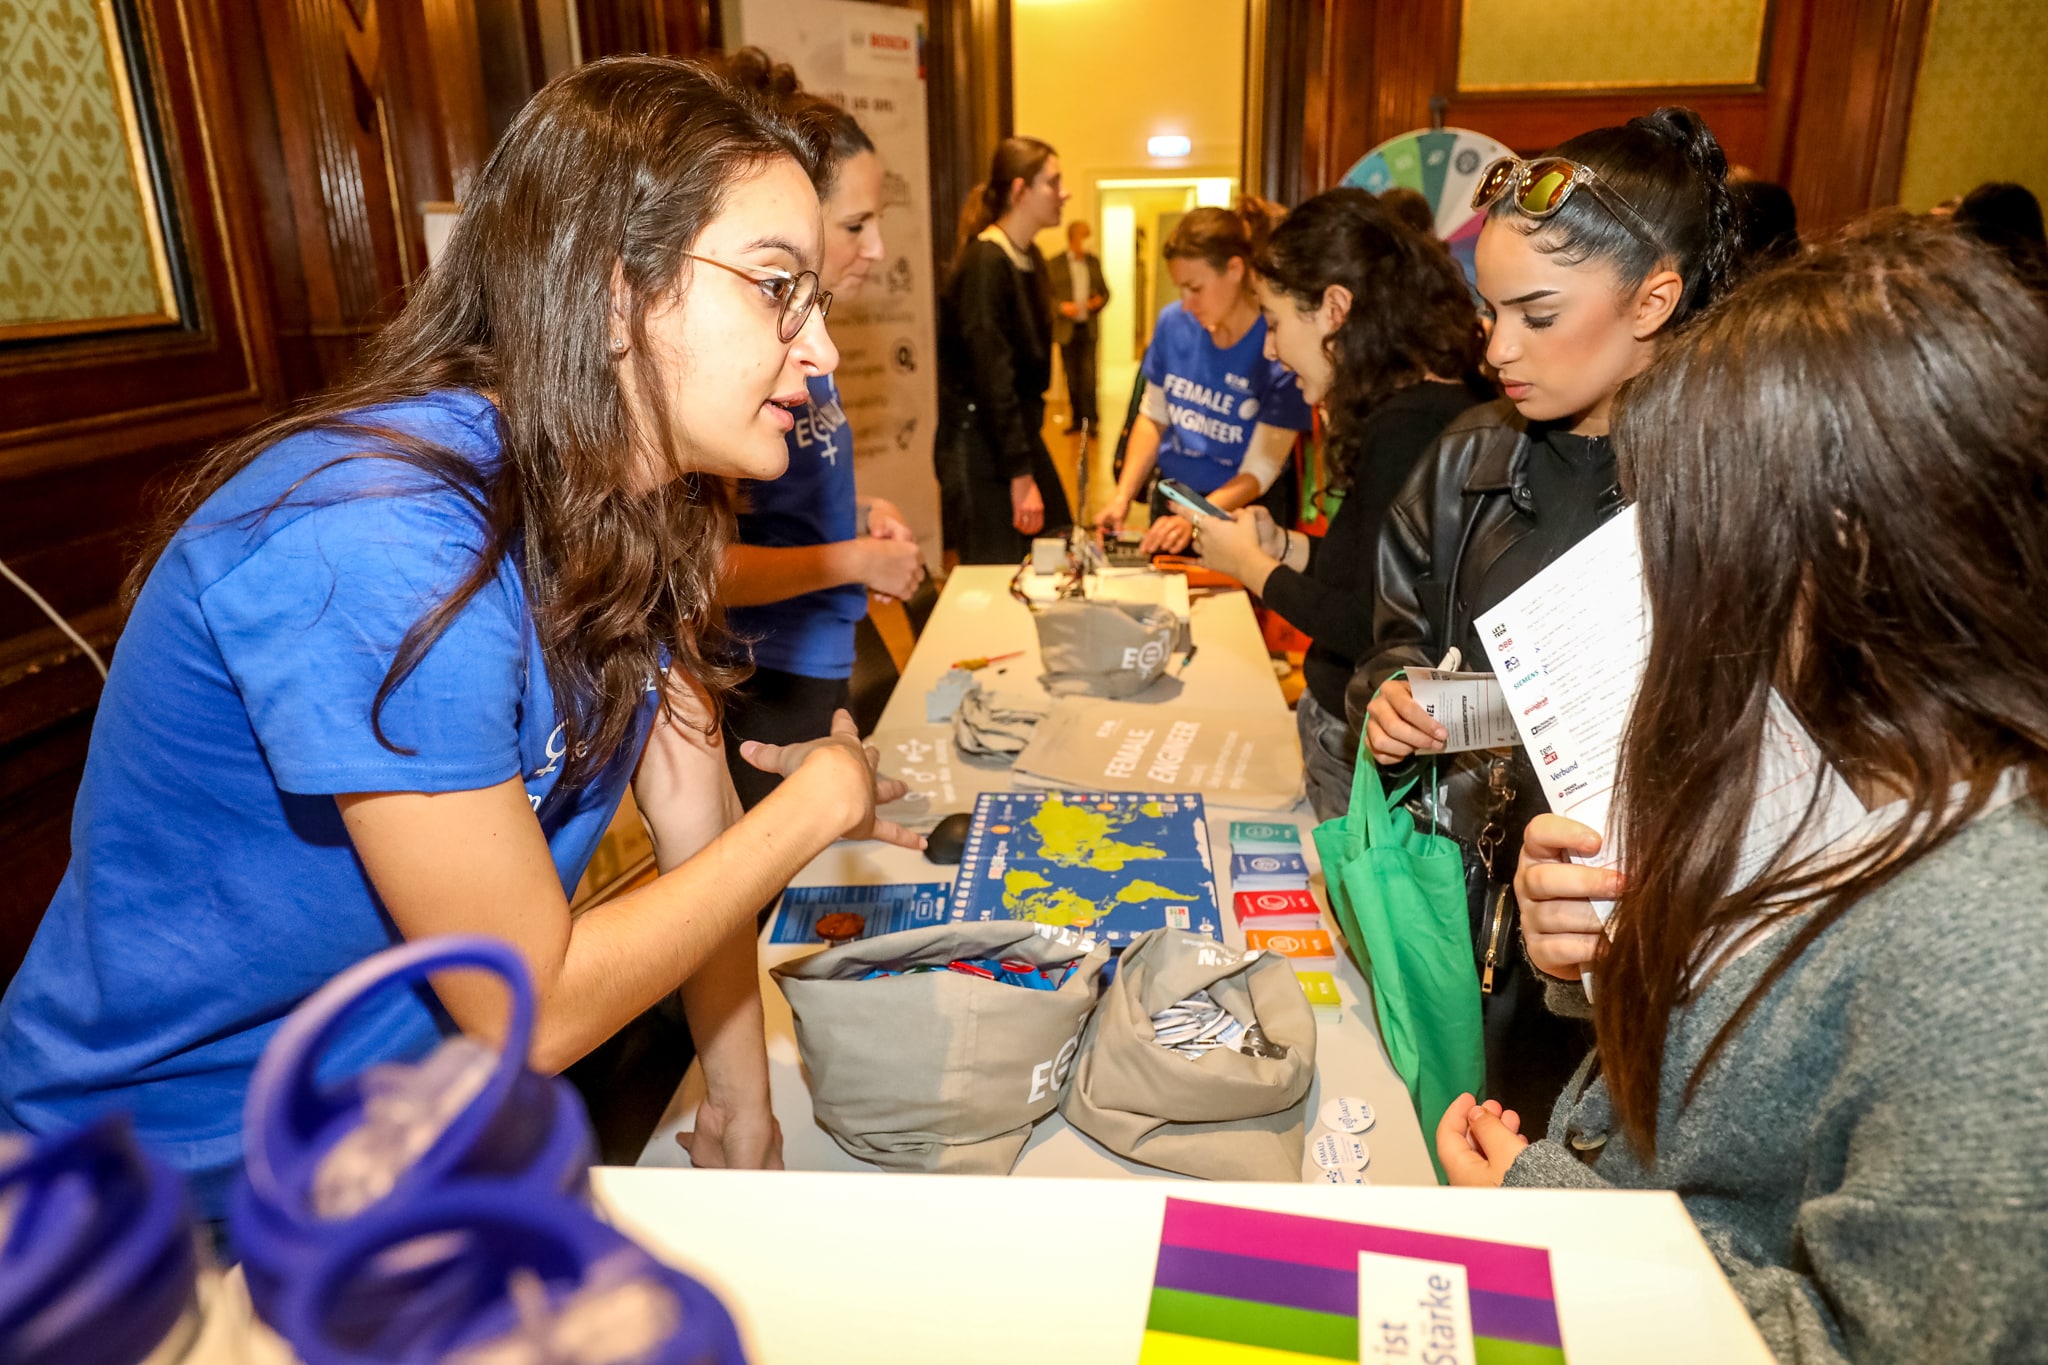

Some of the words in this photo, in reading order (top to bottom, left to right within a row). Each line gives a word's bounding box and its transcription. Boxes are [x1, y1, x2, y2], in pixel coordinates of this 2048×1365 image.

[1164, 373, 1235, 416] FEMALE
[1167, 402, 1244, 444] NGINEER
[1513, 670, 1539, 689] SIEMENS
[1104, 729, 1155, 778] FEMALE
[1147, 720, 1201, 785] ENGINEER
[1550, 761, 1578, 781] Verbund
[1317, 1141, 1328, 1166] FEMALE
[1326, 1135, 1340, 1164] ENGINEER
[1420, 1274, 1458, 1365] Stärke
[1374, 1322, 1408, 1356] ist
